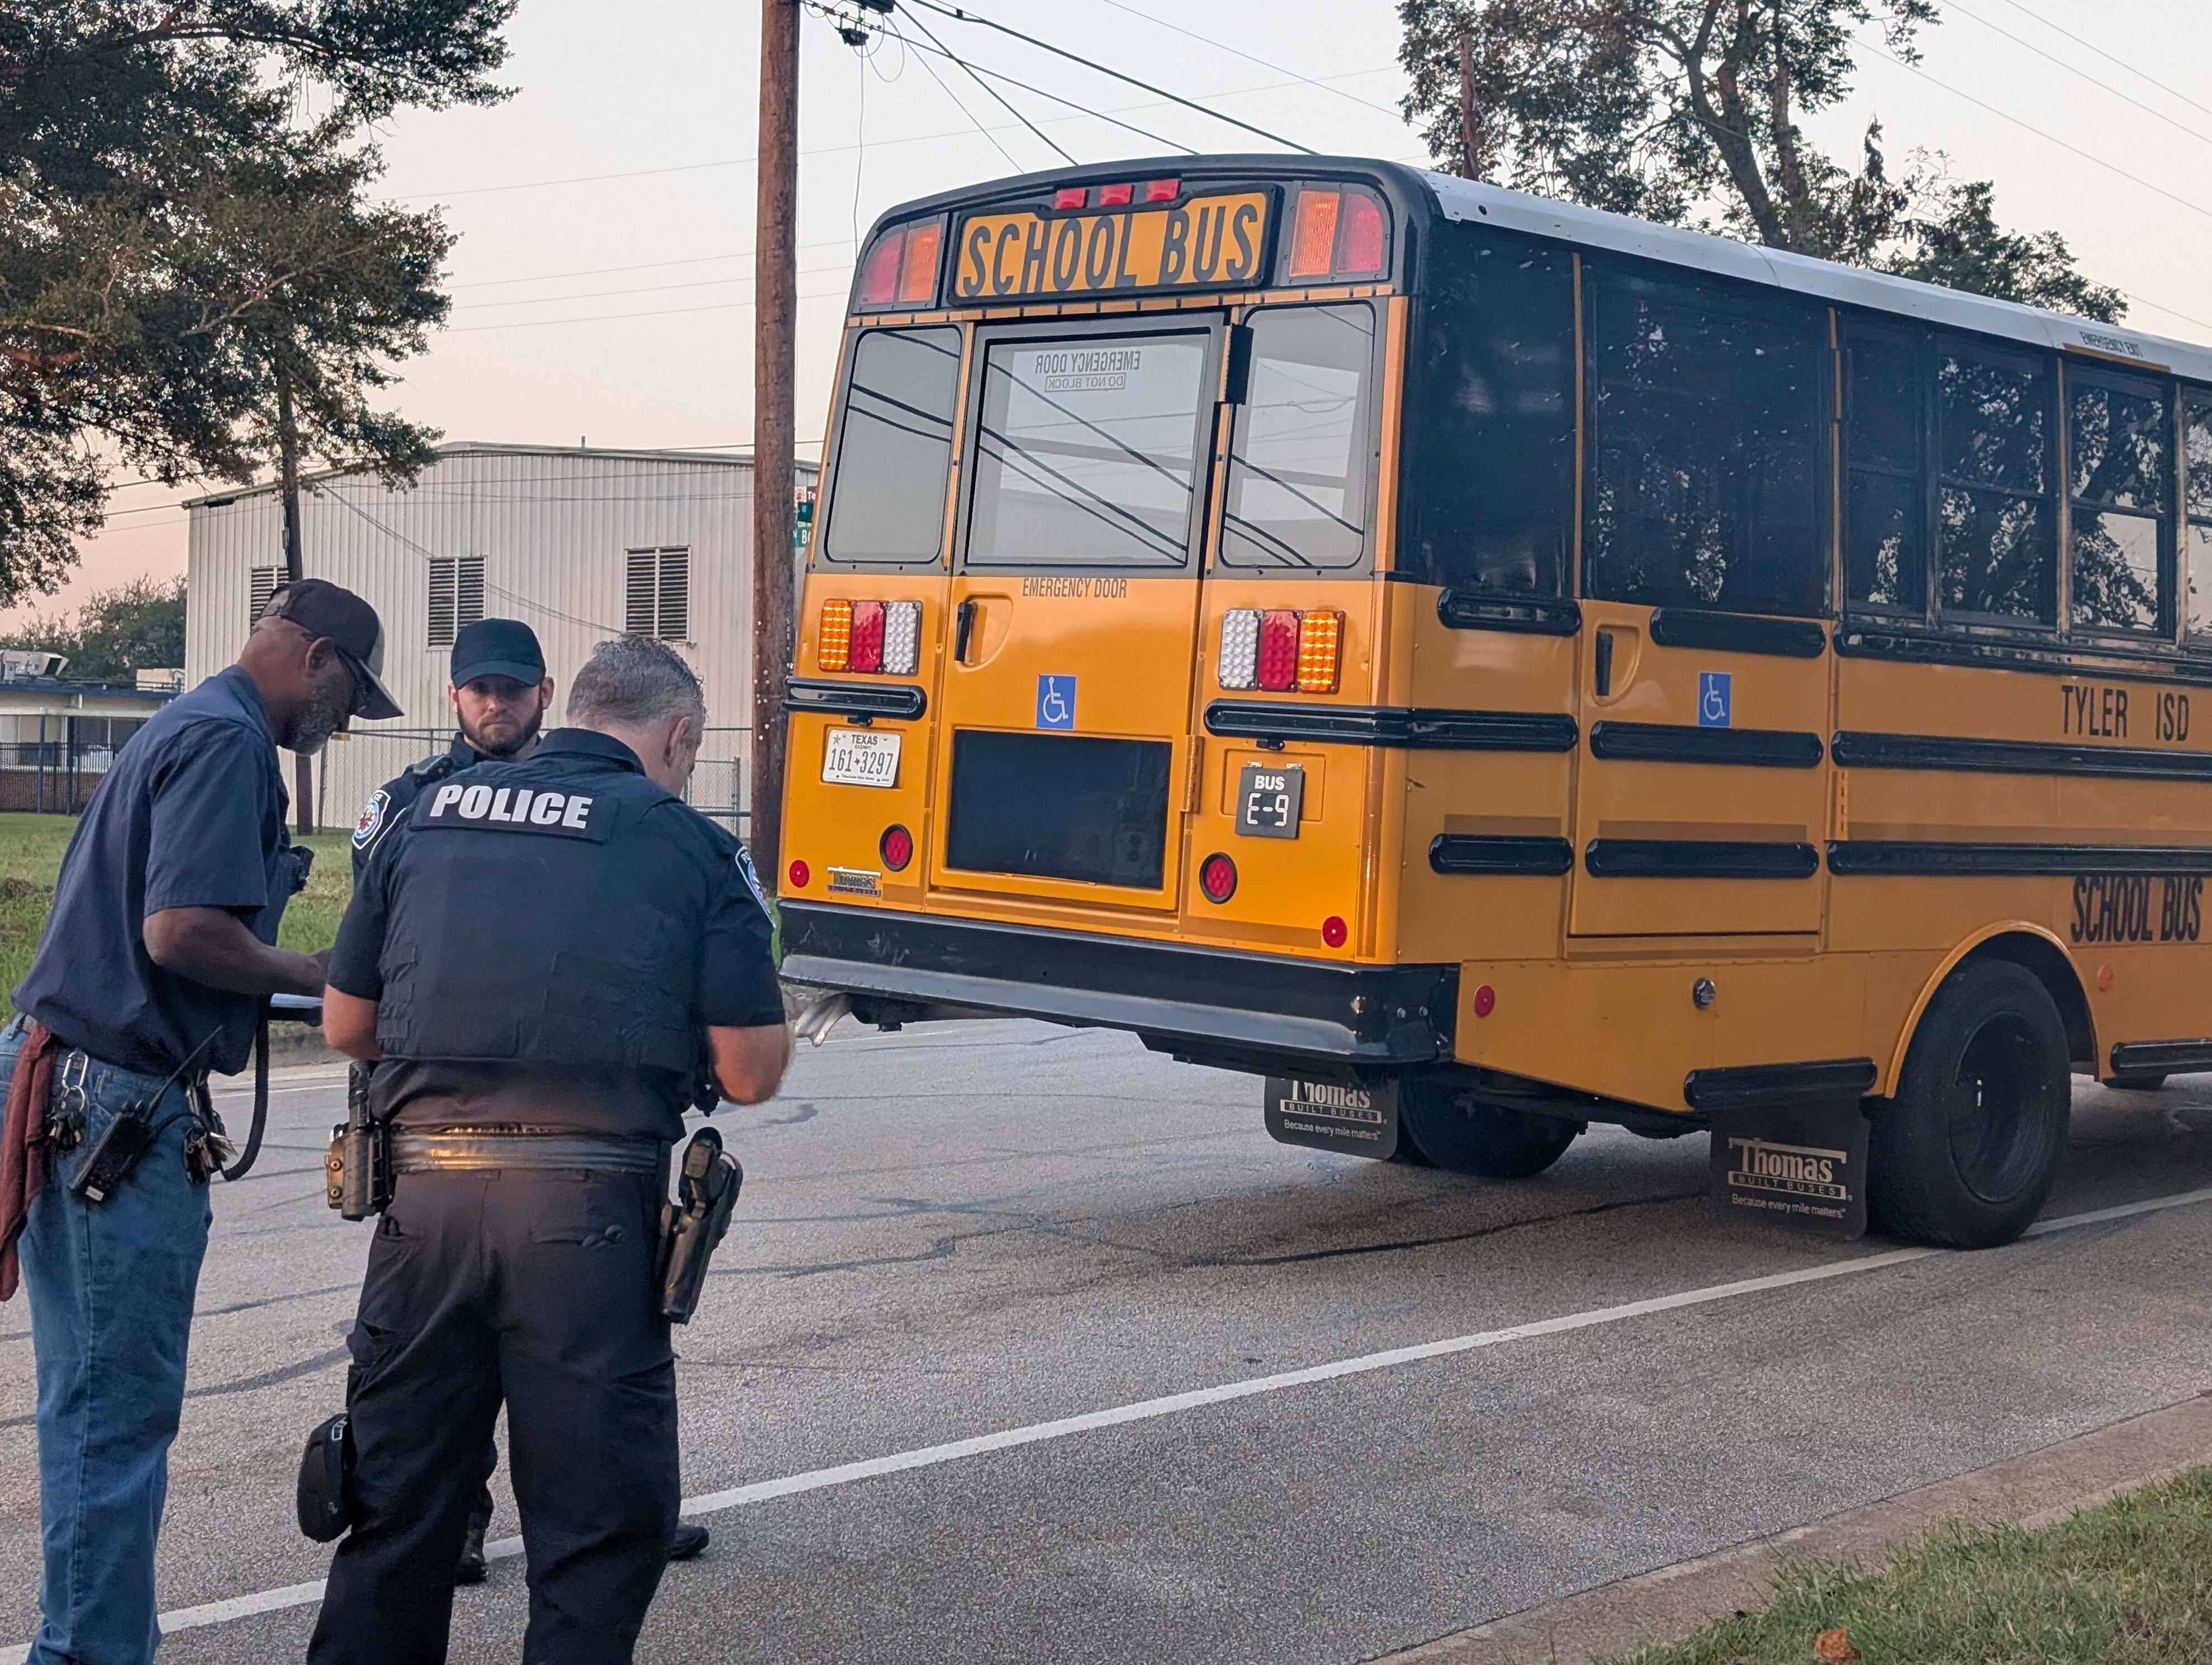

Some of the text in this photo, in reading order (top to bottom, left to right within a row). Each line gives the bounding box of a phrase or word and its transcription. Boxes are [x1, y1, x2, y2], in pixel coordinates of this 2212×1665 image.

[962, 203, 1258, 297] SCHOOL BUS
[1022, 577, 1127, 598] EMERGENCY DOOR
[2061, 684, 2189, 741] TYLER ISD
[851, 734, 878, 745] TEXAS
[1254, 775, 1285, 791] BUS
[429, 784, 593, 829] POLICE
[2070, 876, 2202, 943] SCHOOL BUS
[1289, 1103, 1373, 1120] BUILT BUSES
[1284, 1119, 1313, 1132] Because
[1315, 1125, 1334, 1136] every
[1335, 1126, 1350, 1136] mile
[1728, 1138, 1847, 1183] Thomas
[1738, 1175, 1836, 1196] BUILT BUSES
[1732, 1193, 1767, 1207] Because
[1768, 1201, 1791, 1214] every
[1792, 1202, 1810, 1214] mile
